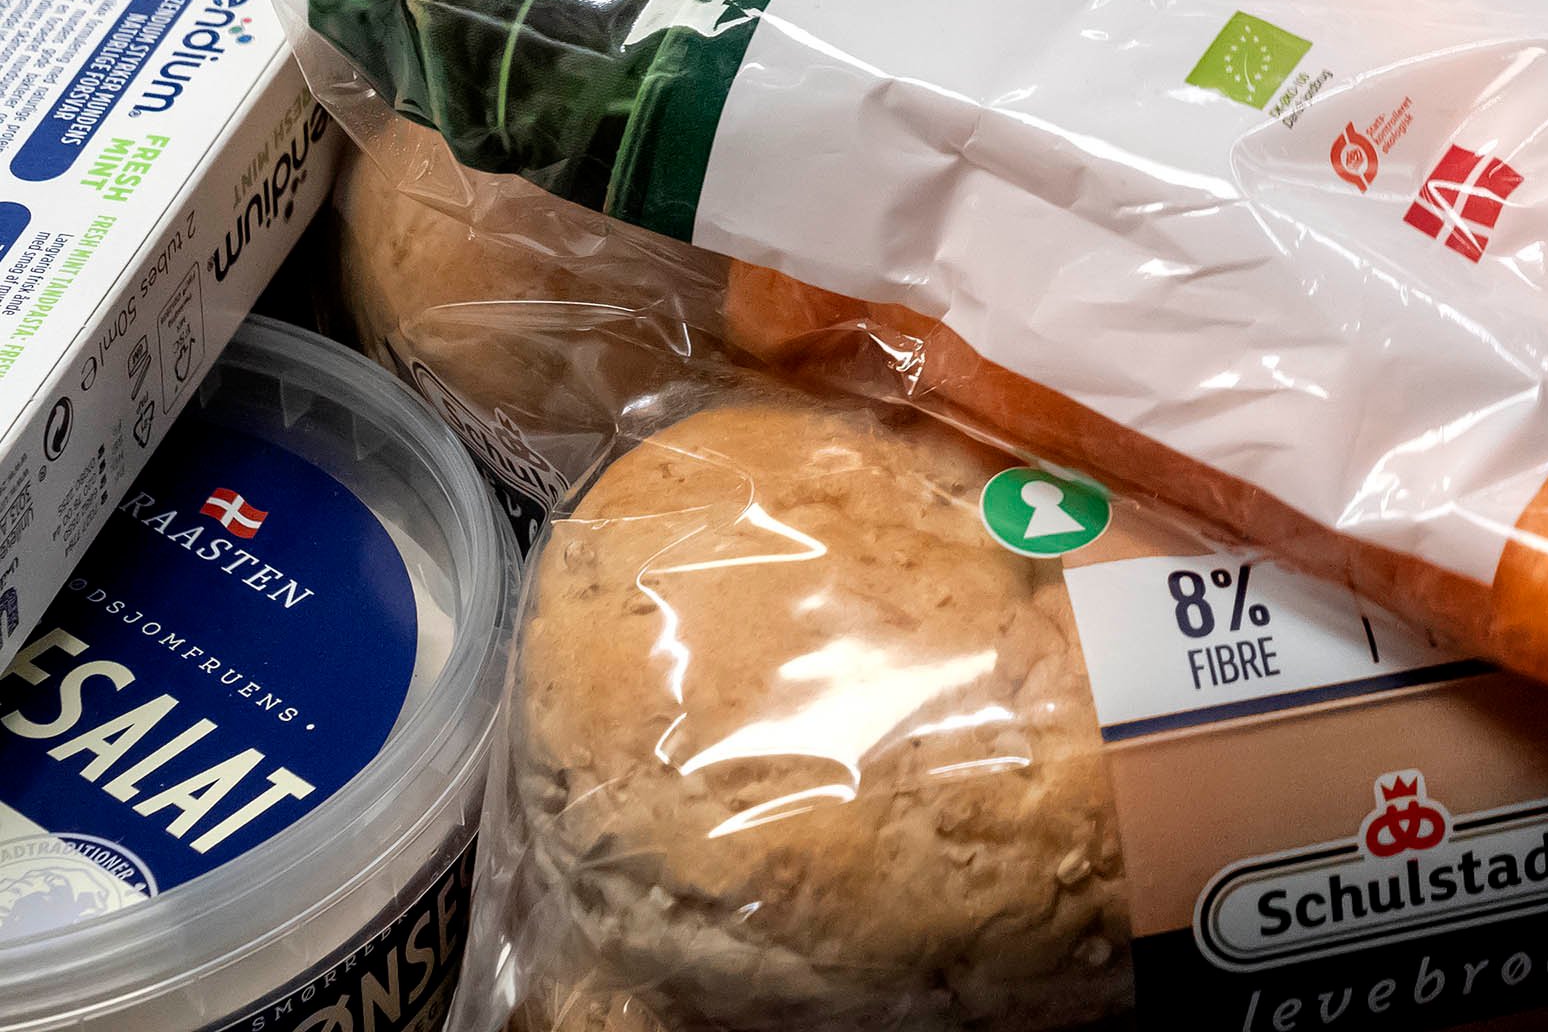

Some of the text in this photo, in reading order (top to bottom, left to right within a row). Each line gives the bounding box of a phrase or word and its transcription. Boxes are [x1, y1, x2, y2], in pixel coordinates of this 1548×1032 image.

[89, 12, 147, 71] NATURLIGE
[100, 42, 149, 90] STYRKER
[52, 71, 102, 121] FORSVAR
[59, 94, 112, 146] MUNDENS
[80, 137, 127, 190] MINT
[103, 134, 170, 202] FRESH
[211, 104, 331, 282] endium
[26, 231, 51, 251] med
[79, 214, 117, 246] FRESH
[179, 210, 201, 238] 2
[8, 250, 34, 274] smag
[31, 233, 70, 275] Langvarig
[57, 248, 92, 277] MINT
[138, 231, 184, 293] tubes
[17, 274, 44, 295] frisk
[120, 491, 315, 609] RAASTEN
[1167, 564, 1271, 639] 8%
[69, 577, 300, 725] ØDSJOMFRUENS
[1187, 636, 1281, 690] FIBRE
[2, 628, 316, 855] ESALAT
[0, 834, 134, 881] ADTRADITIONER
